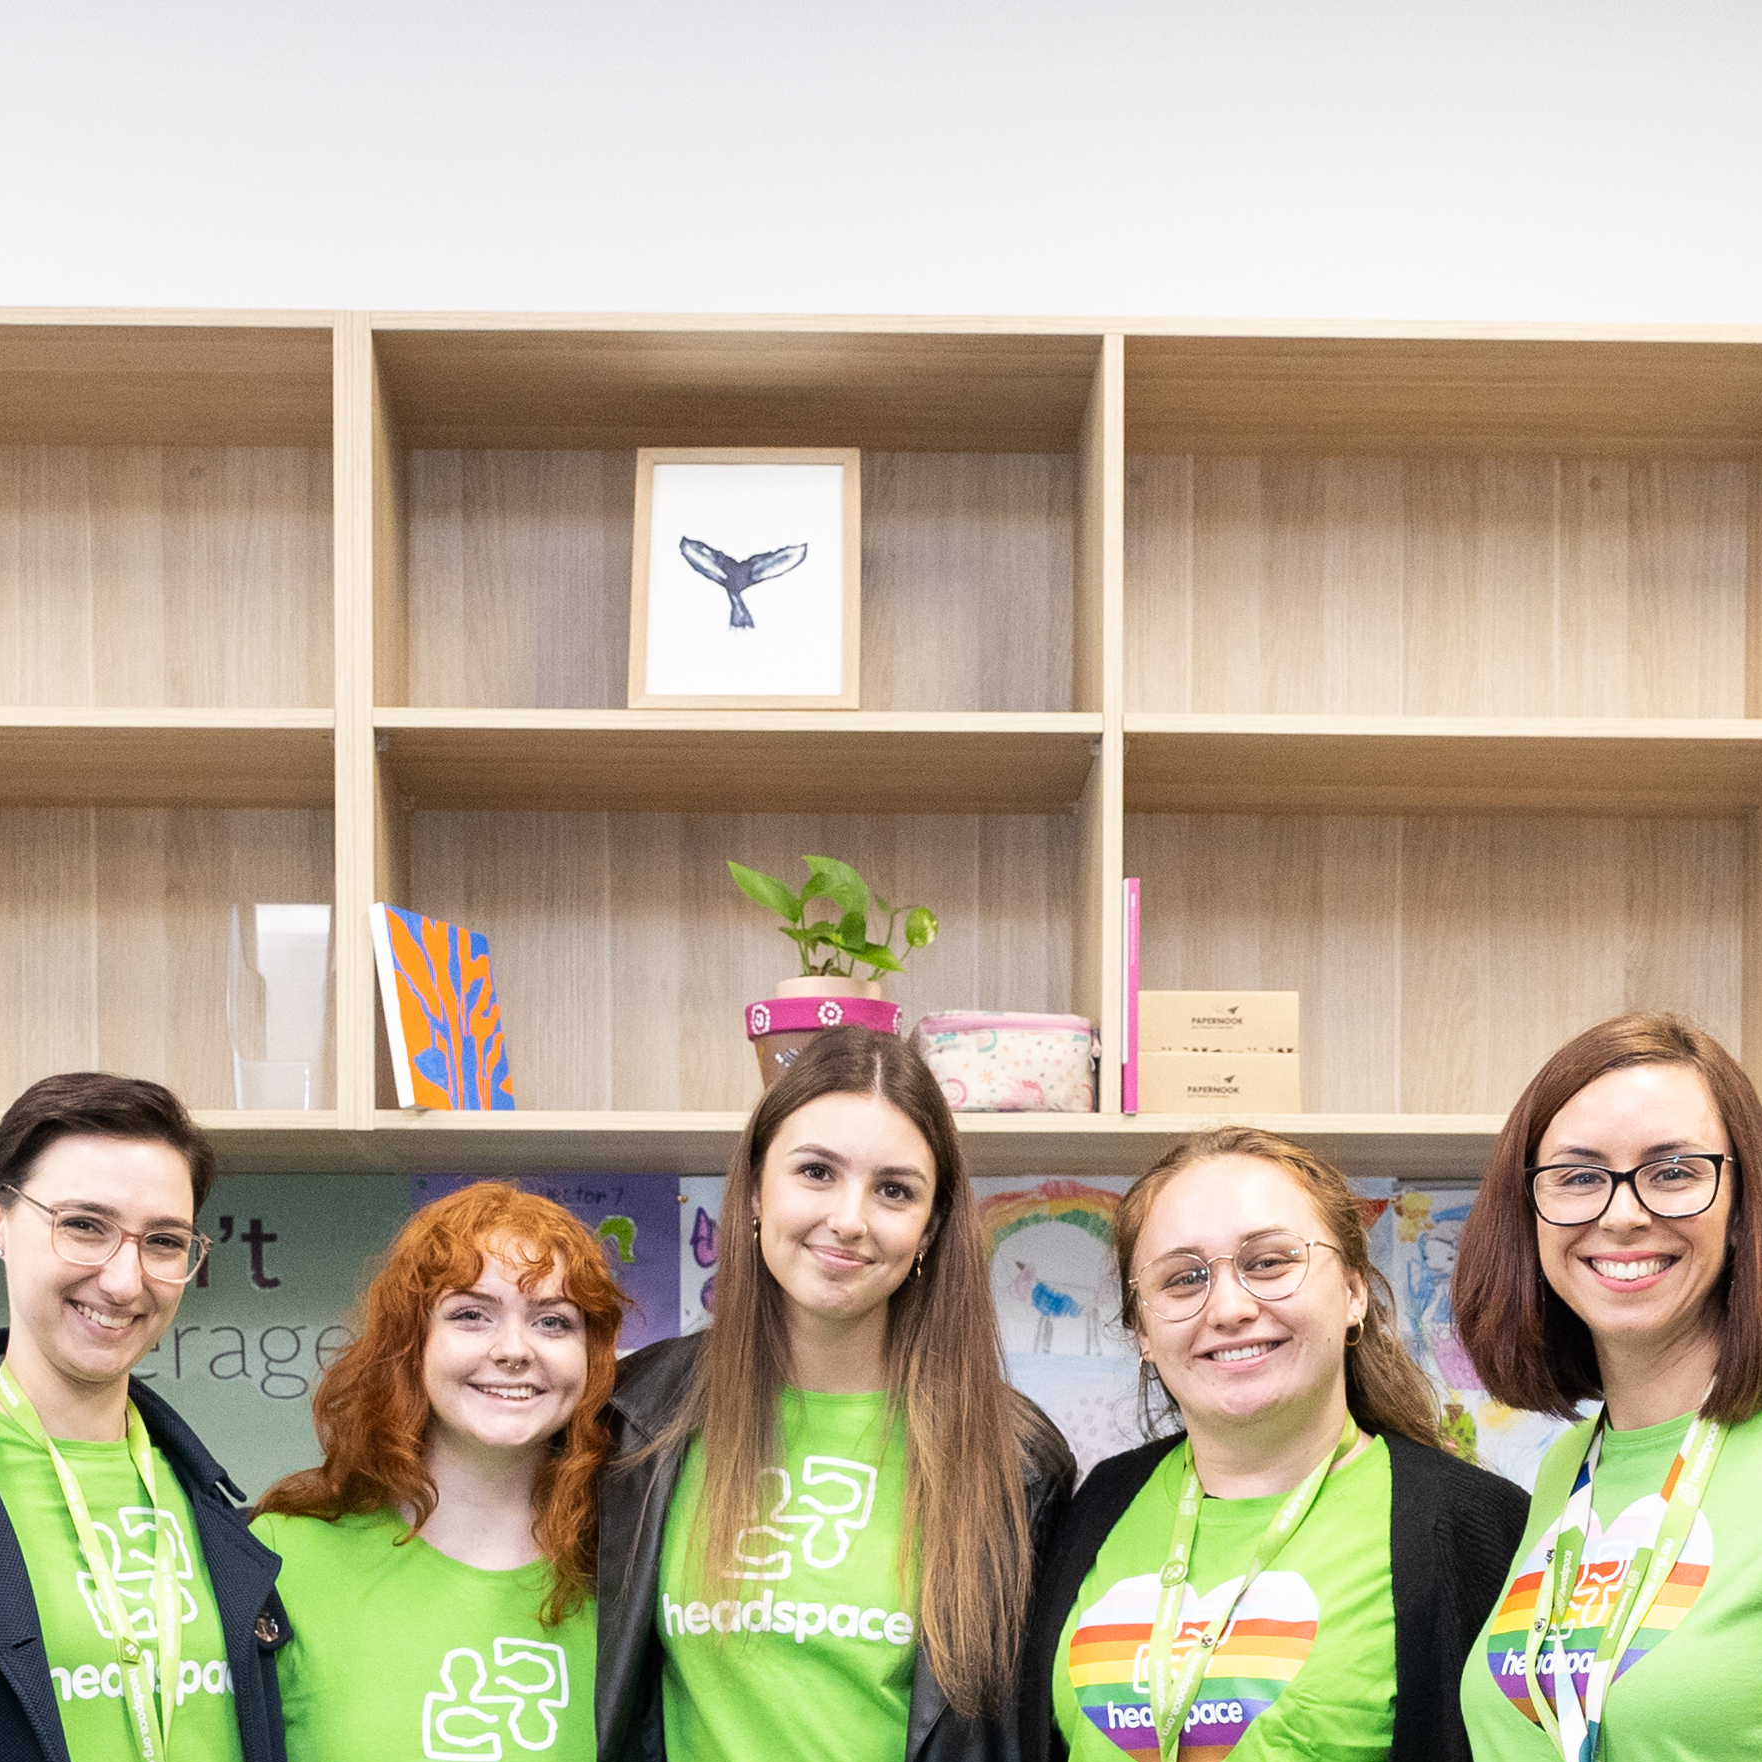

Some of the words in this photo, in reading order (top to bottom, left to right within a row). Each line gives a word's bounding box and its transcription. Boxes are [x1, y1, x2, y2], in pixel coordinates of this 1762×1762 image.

[1191, 1016, 1244, 1025] PAPERNOOK
[1186, 1085, 1240, 1094] PAPERNOOK
[1688, 1421, 1720, 1486] headspace
[662, 1588, 915, 1646] headspace
[1107, 1699, 1244, 1734] heapace
